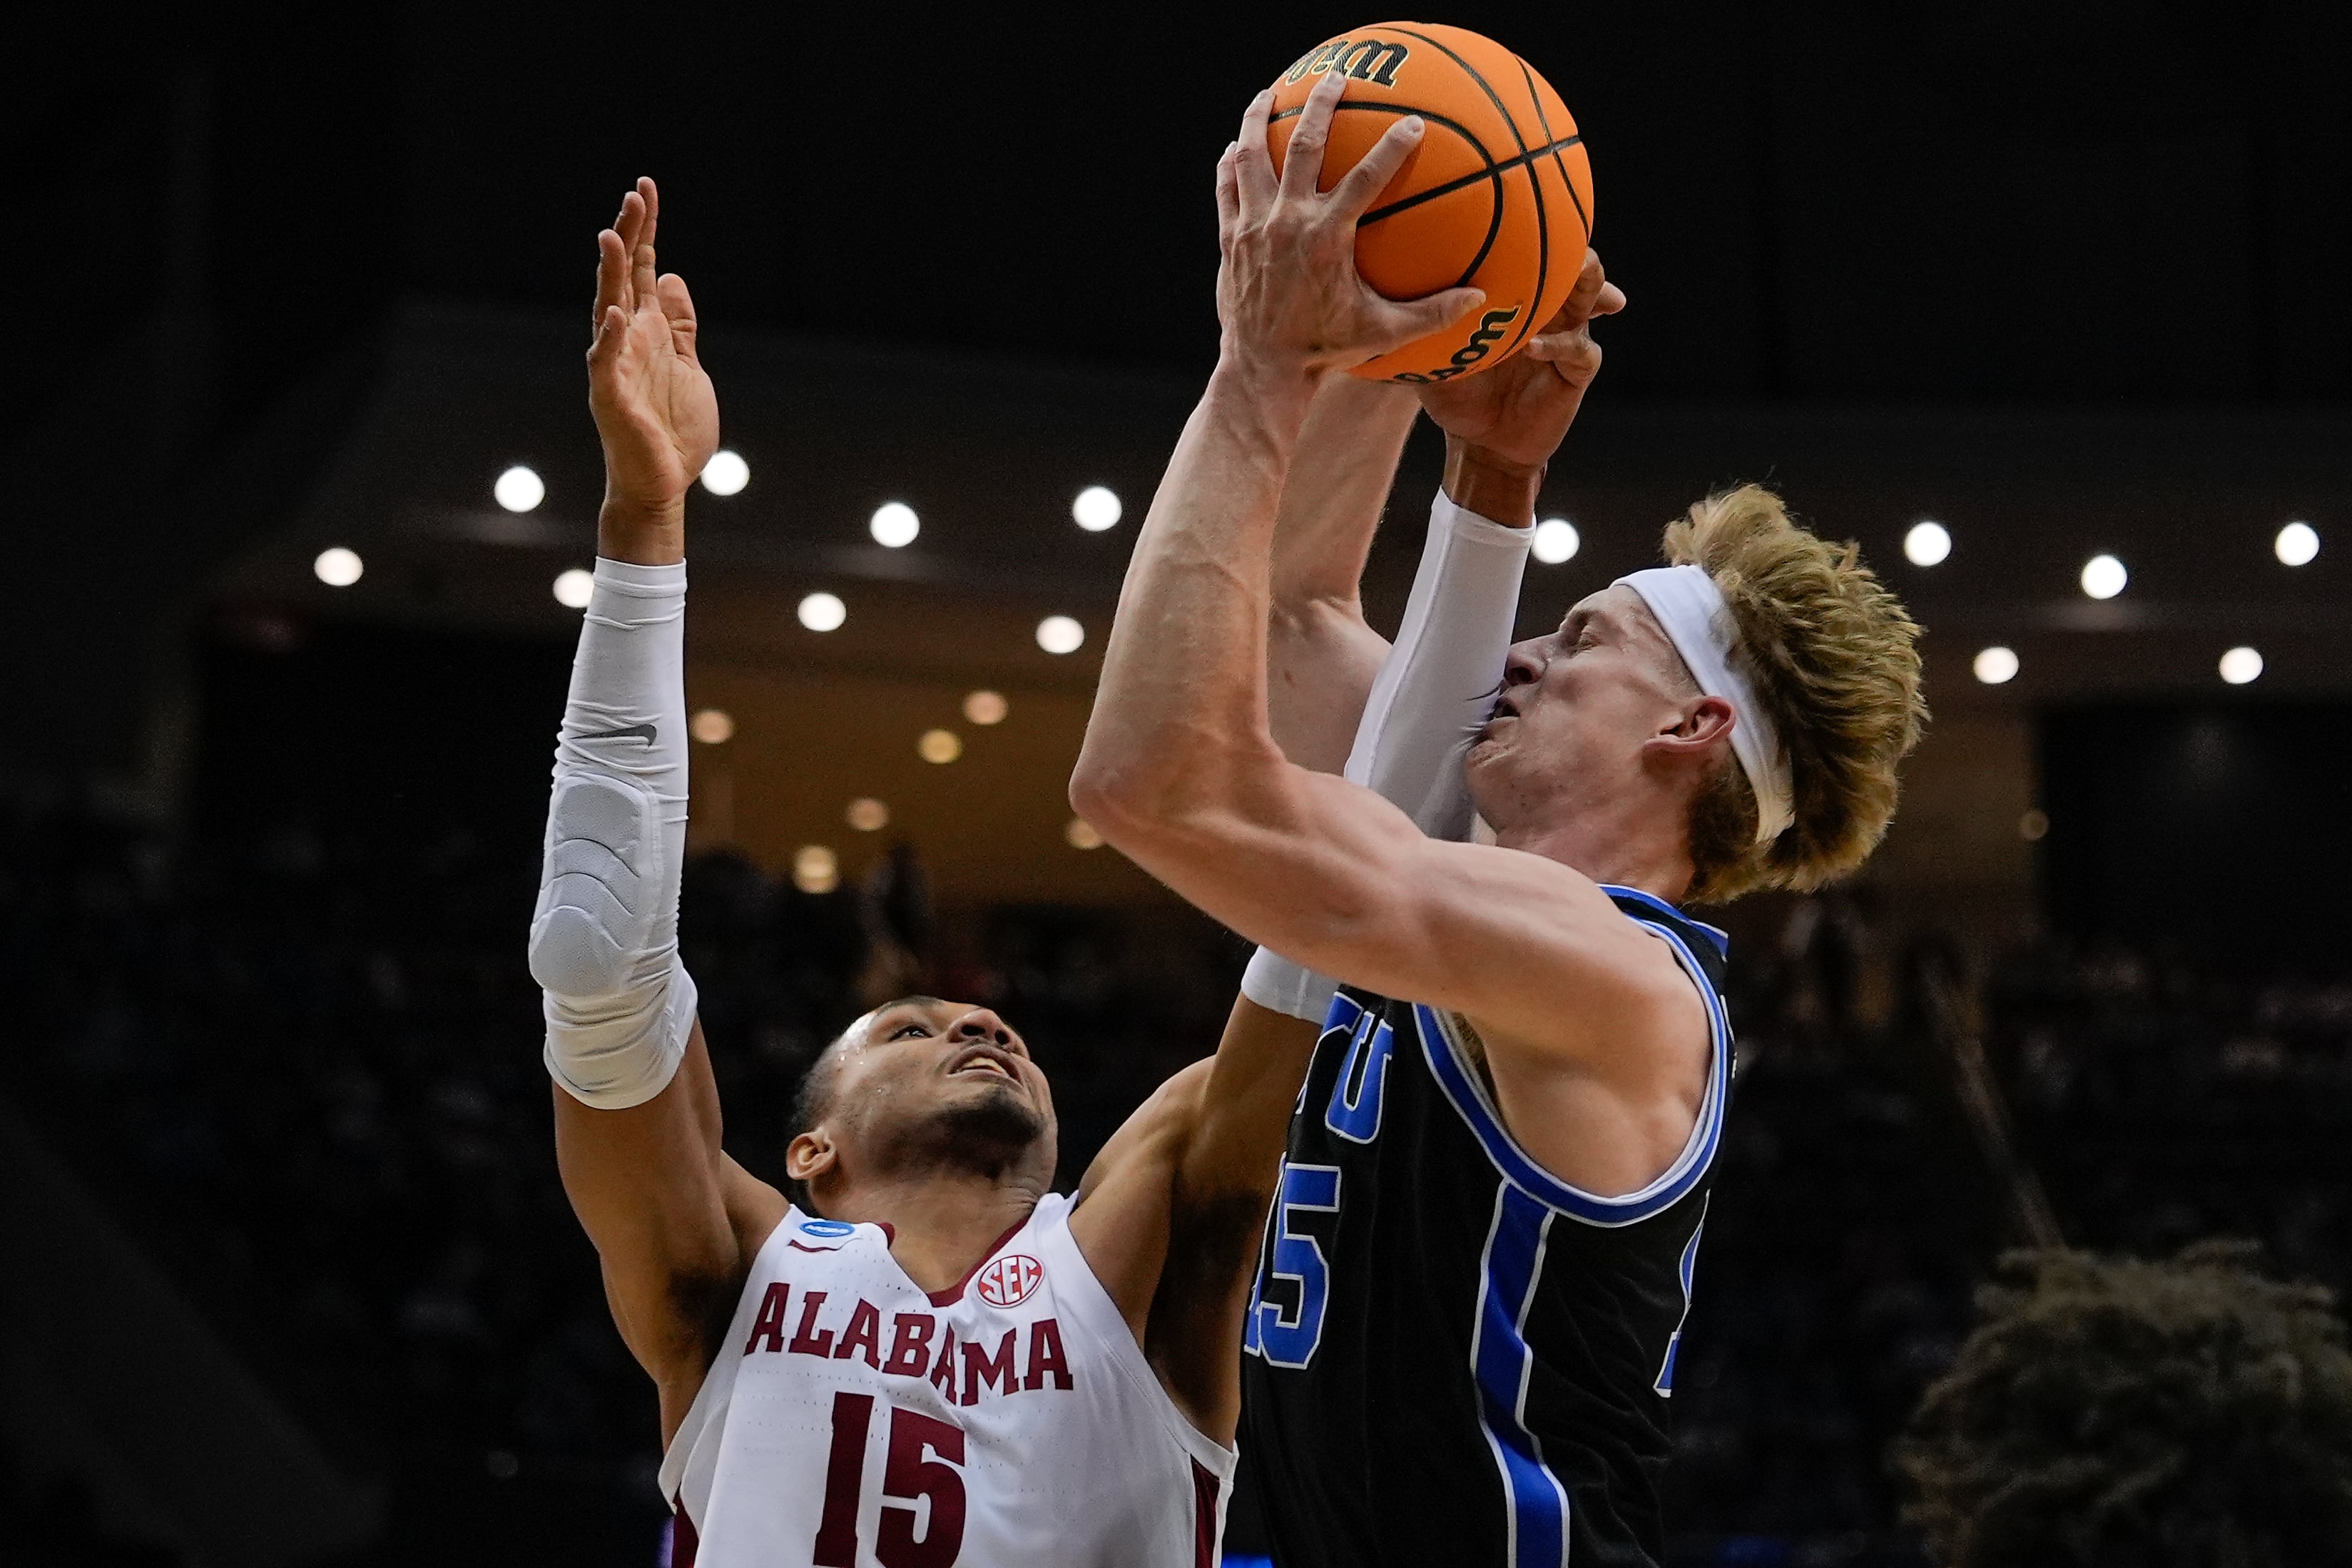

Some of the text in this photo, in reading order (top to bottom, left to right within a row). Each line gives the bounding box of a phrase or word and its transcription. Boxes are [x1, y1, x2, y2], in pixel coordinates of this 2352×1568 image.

[979, 1256, 1042, 1305] SEC
[743, 1282, 1074, 1407] ALABAMA
[813, 1391, 967, 1568] 15
